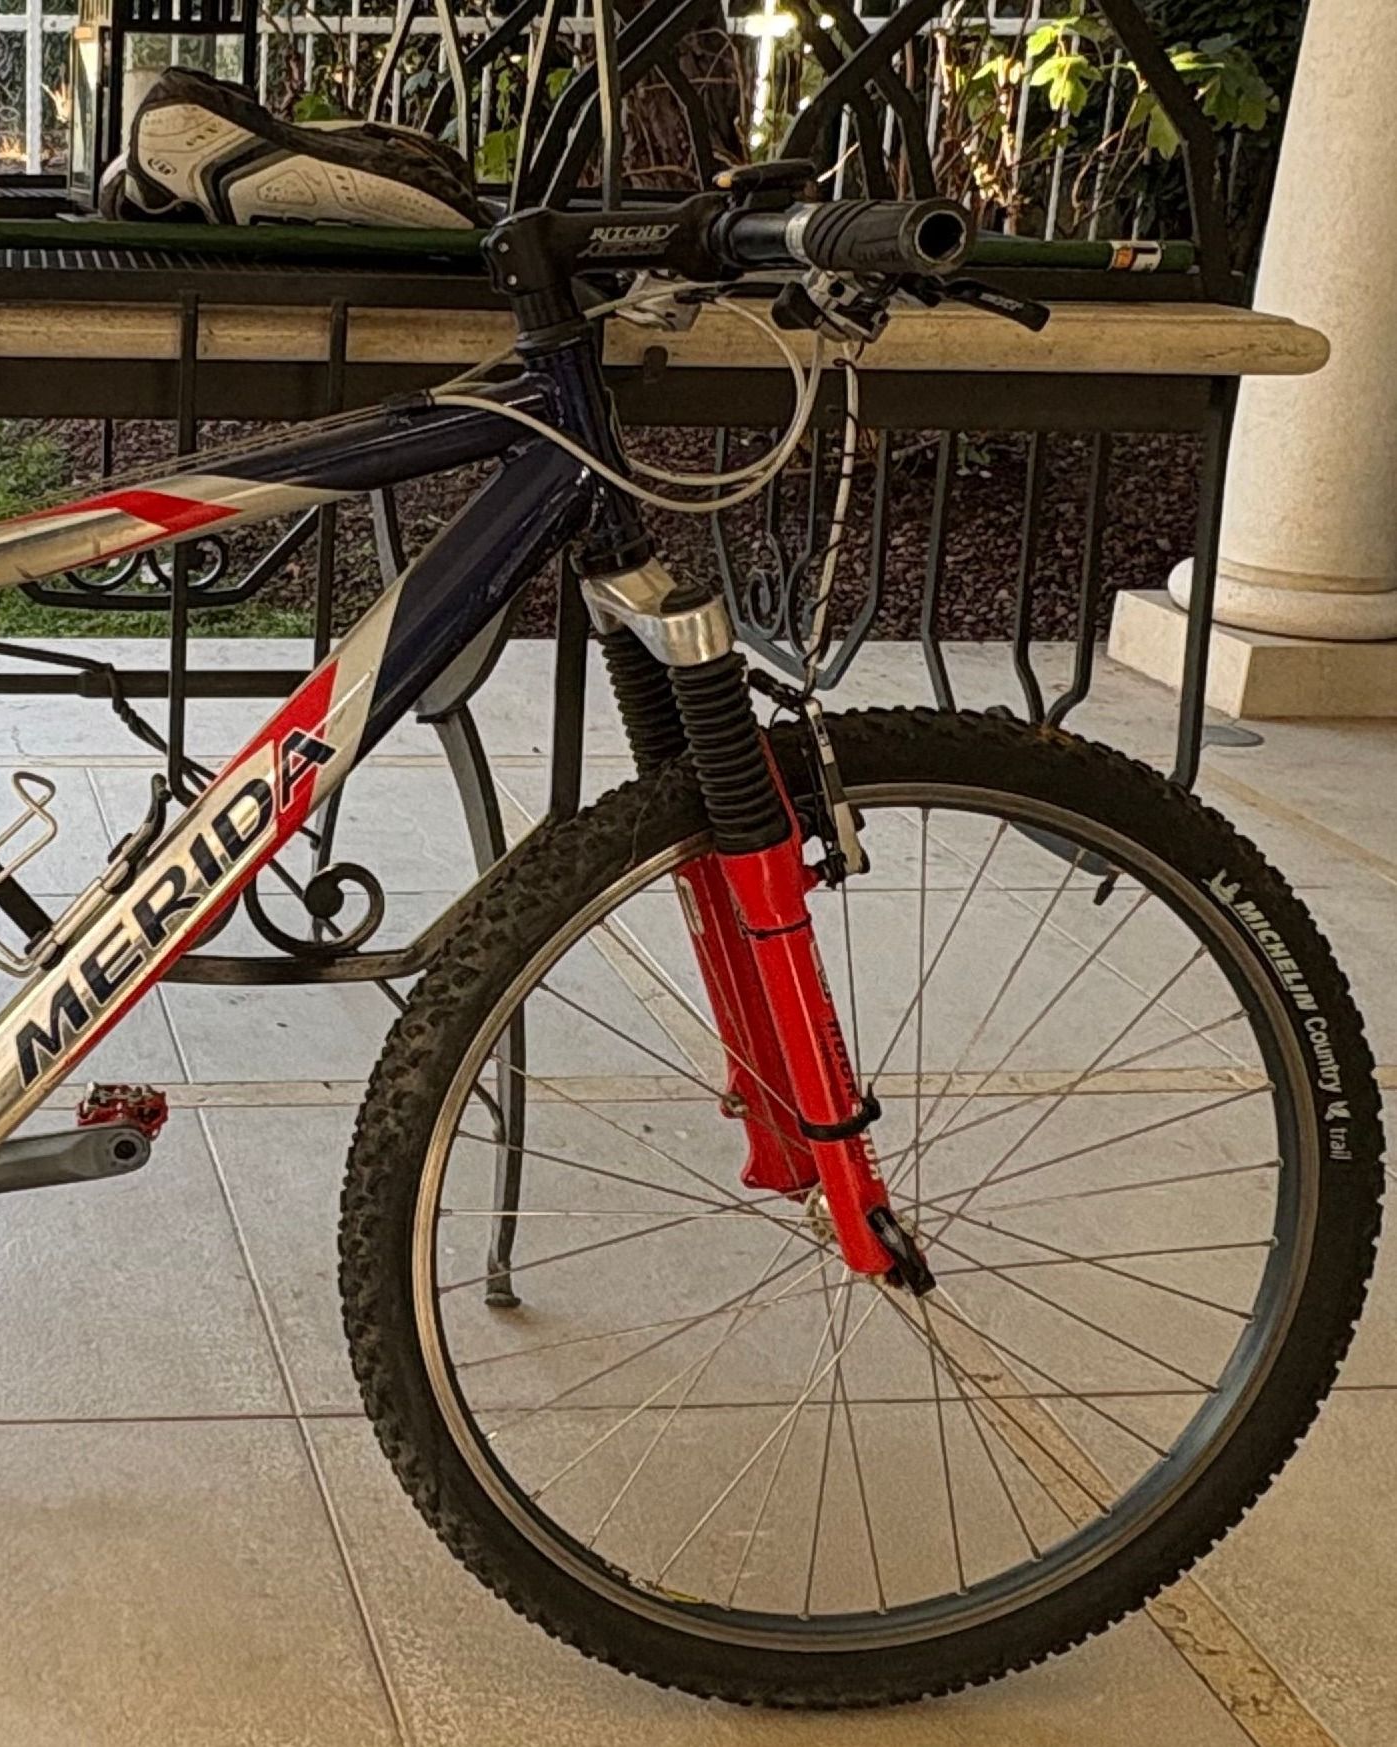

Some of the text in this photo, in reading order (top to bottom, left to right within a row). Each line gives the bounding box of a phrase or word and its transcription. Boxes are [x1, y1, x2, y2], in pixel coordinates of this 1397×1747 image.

[15, 726, 337, 1090] MERIDA
[1233, 901, 1353, 1161] MICHELIN Country trail
